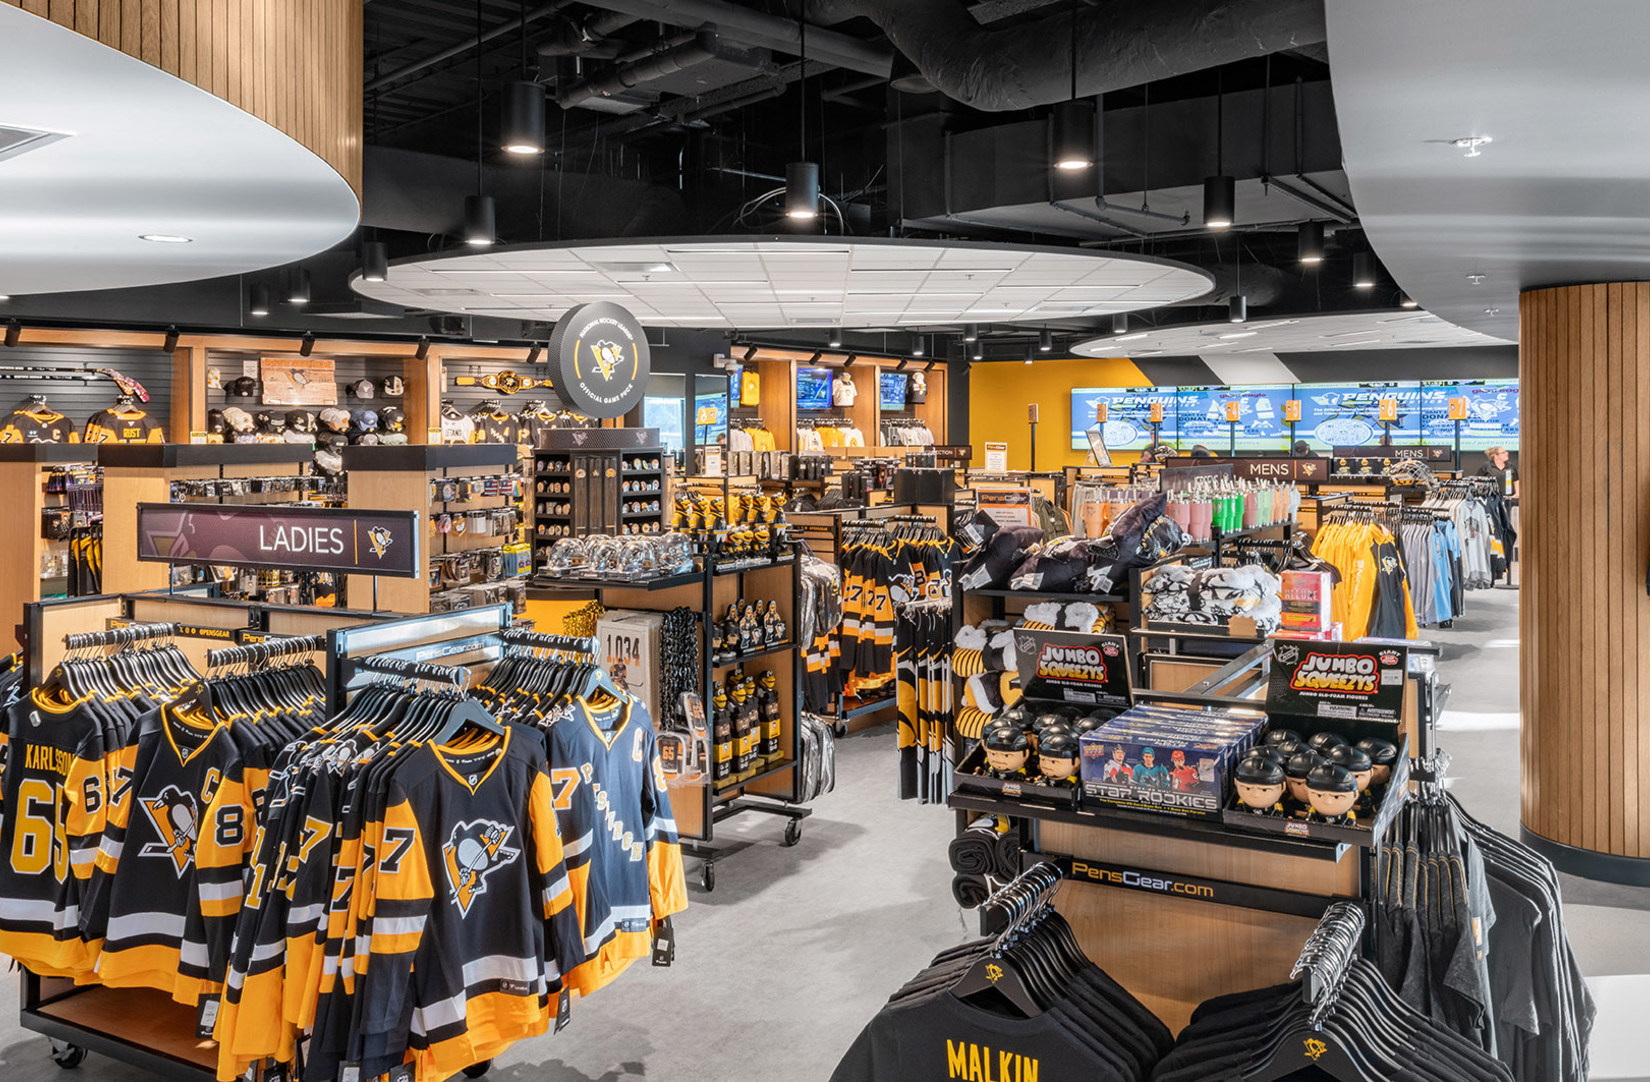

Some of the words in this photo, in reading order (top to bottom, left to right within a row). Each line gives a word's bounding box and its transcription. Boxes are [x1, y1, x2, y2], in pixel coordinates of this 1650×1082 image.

[599, 317, 618, 326] HOCKEY
[580, 382, 603, 403] OFFICIAL
[604, 395, 620, 404] GAME
[620, 383, 633, 398] PUCK
[1111, 395, 1199, 405] PENGUINS
[1342, 391, 1446, 401] PENGUINS
[1387, 400, 1394, 417] 6
[1457, 398, 1464, 416] 7
[122, 428, 141, 438] RUST
[1395, 449, 1424, 458] MENS
[1250, 463, 1289, 476] MENS
[259, 525, 344, 554] LADIES
[1285, 589, 1318, 600] ALLURE
[1042, 646, 1100, 665] JUMBO
[1378, 649, 1401, 657] GIANT
[1039, 660, 1105, 680] SQUEEZYS
[1302, 655, 1374, 675] JUMBO
[1294, 671, 1377, 691] SQUEEZYS
[632, 727, 644, 763] C
[662, 744, 675, 762] 65
[201, 767, 220, 804] C
[551, 767, 581, 810] 7
[1085, 784, 1132, 799] STAR
[1137, 790, 1218, 810] ROOKIES
[10, 778, 69, 885] 65
[214, 803, 244, 847] 8
[299, 815, 333, 863] 7
[379, 827, 416, 873] 7
[1072, 862, 1214, 897] PensGear.com
[946, 1039, 1039, 1082] MALKIN
